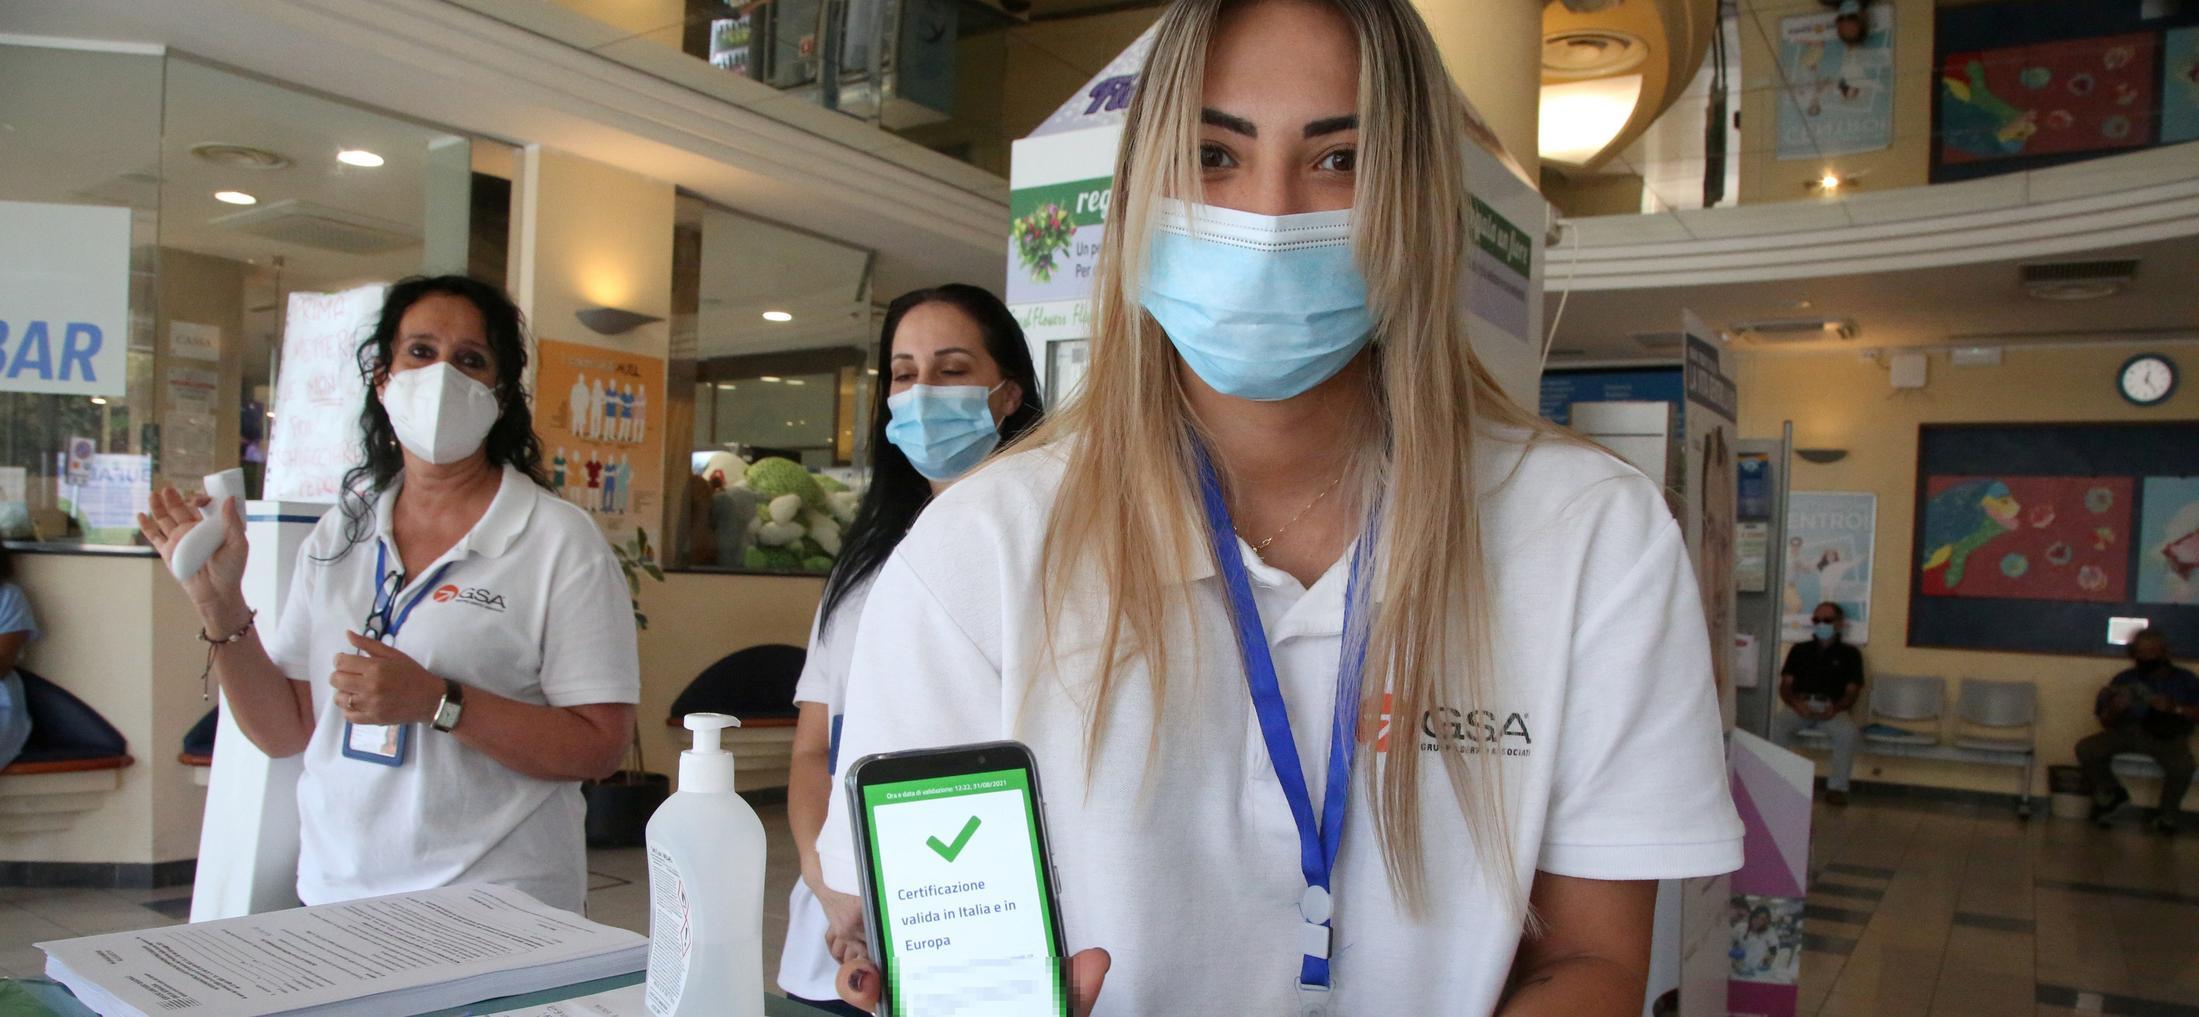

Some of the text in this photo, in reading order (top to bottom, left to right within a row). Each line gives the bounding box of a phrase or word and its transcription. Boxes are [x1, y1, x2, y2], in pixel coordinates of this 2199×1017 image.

[1076, 243, 1089, 257] Un
[1075, 264, 1091, 278] Per
[0, 319, 103, 382] AR
[459, 587, 506, 609] GSA
[1421, 706, 1532, 744] GSA
[898, 880, 985, 901] Certificazione
[902, 899, 1017, 926] valida in Italia e in
[905, 936, 951, 951] Europa
